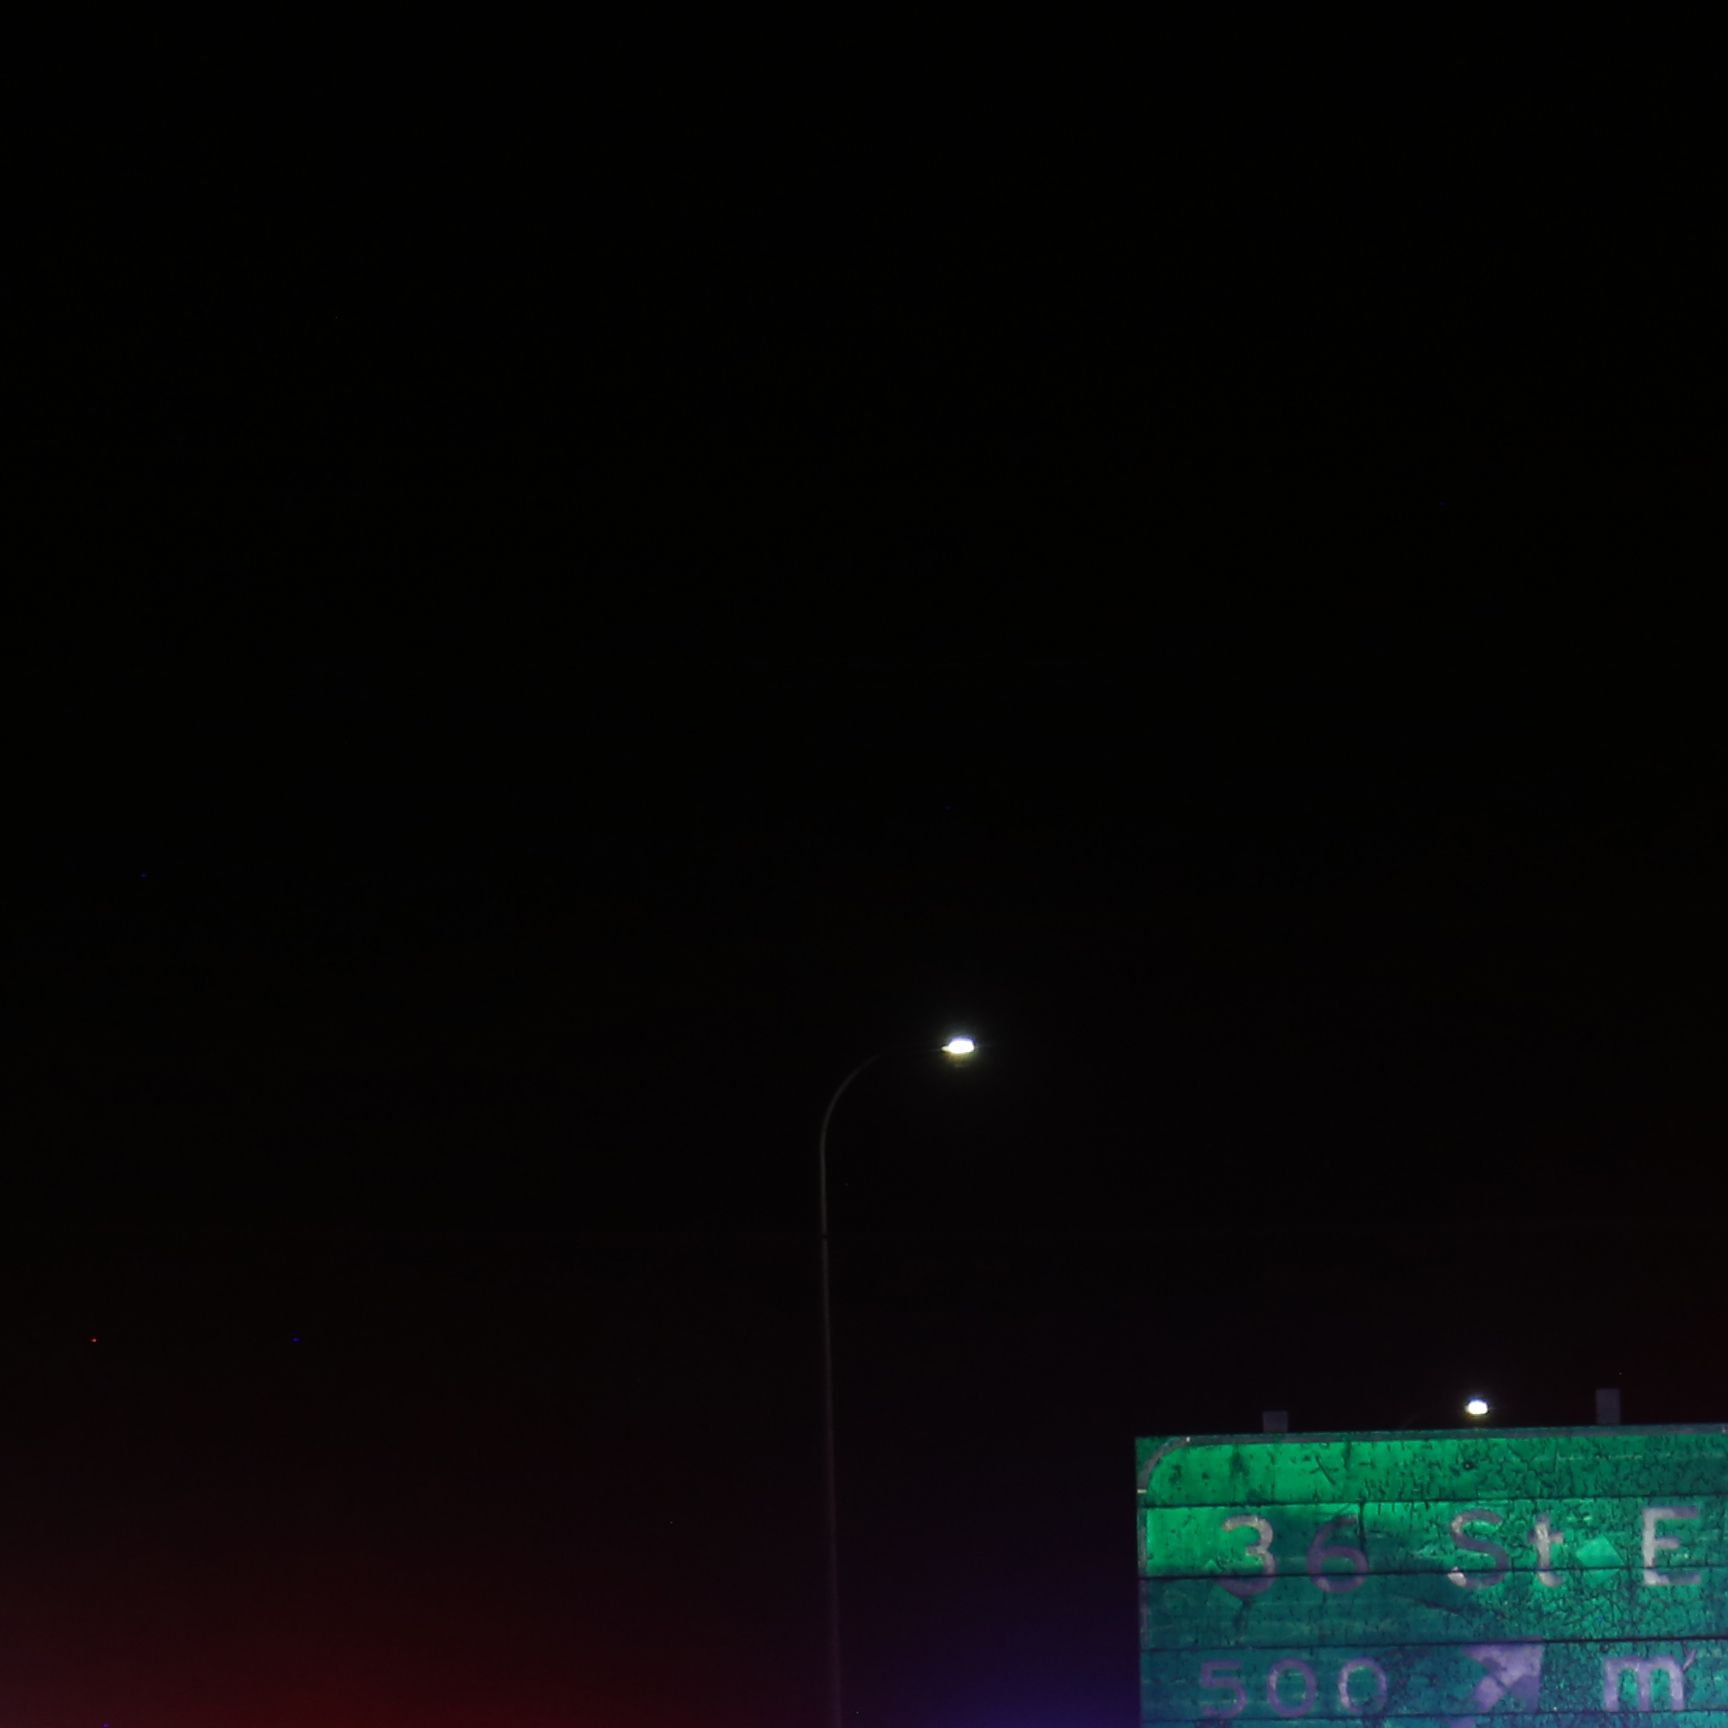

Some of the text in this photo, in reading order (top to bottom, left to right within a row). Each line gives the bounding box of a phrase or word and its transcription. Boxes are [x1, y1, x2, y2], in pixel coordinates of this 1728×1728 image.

[1217, 1504, 1703, 1598] 36 St E
[1198, 1654, 1686, 1718] 500 m
